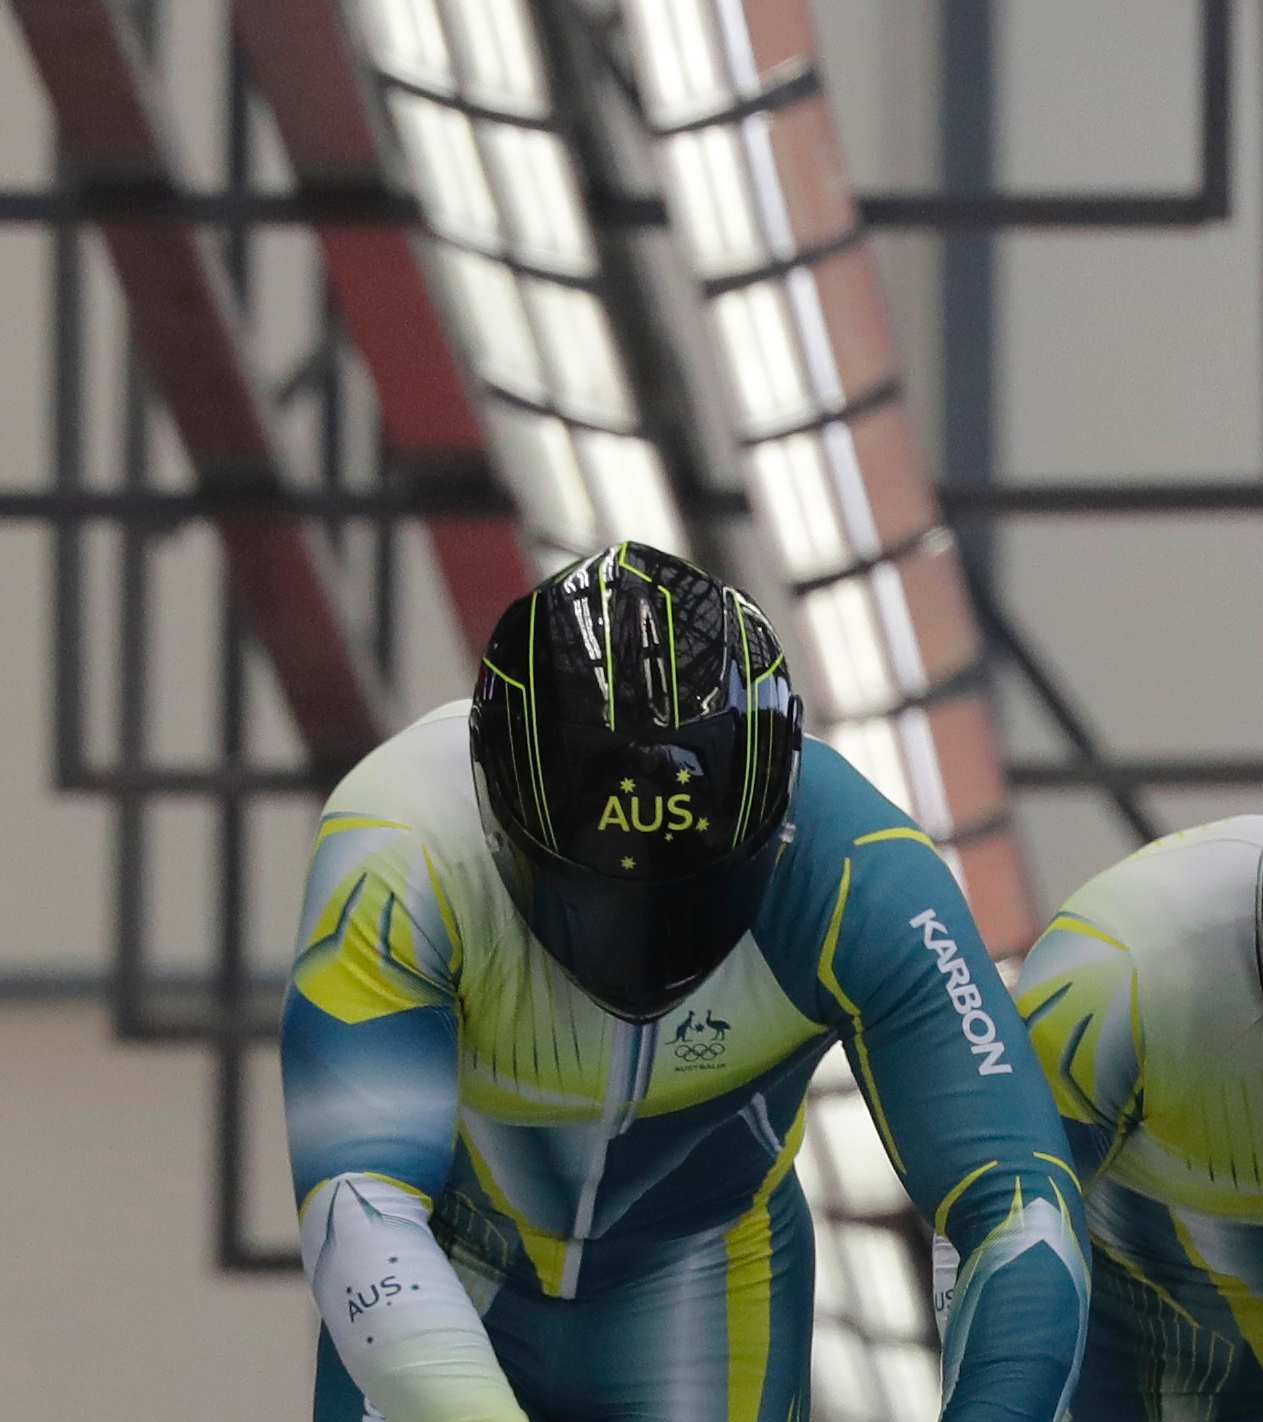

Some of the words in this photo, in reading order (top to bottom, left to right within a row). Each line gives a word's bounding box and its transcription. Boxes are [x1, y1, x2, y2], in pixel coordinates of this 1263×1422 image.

[598, 793, 693, 832] AUS
[909, 908, 1014, 1076] KARBON
[347, 1275, 402, 1323] AUS
